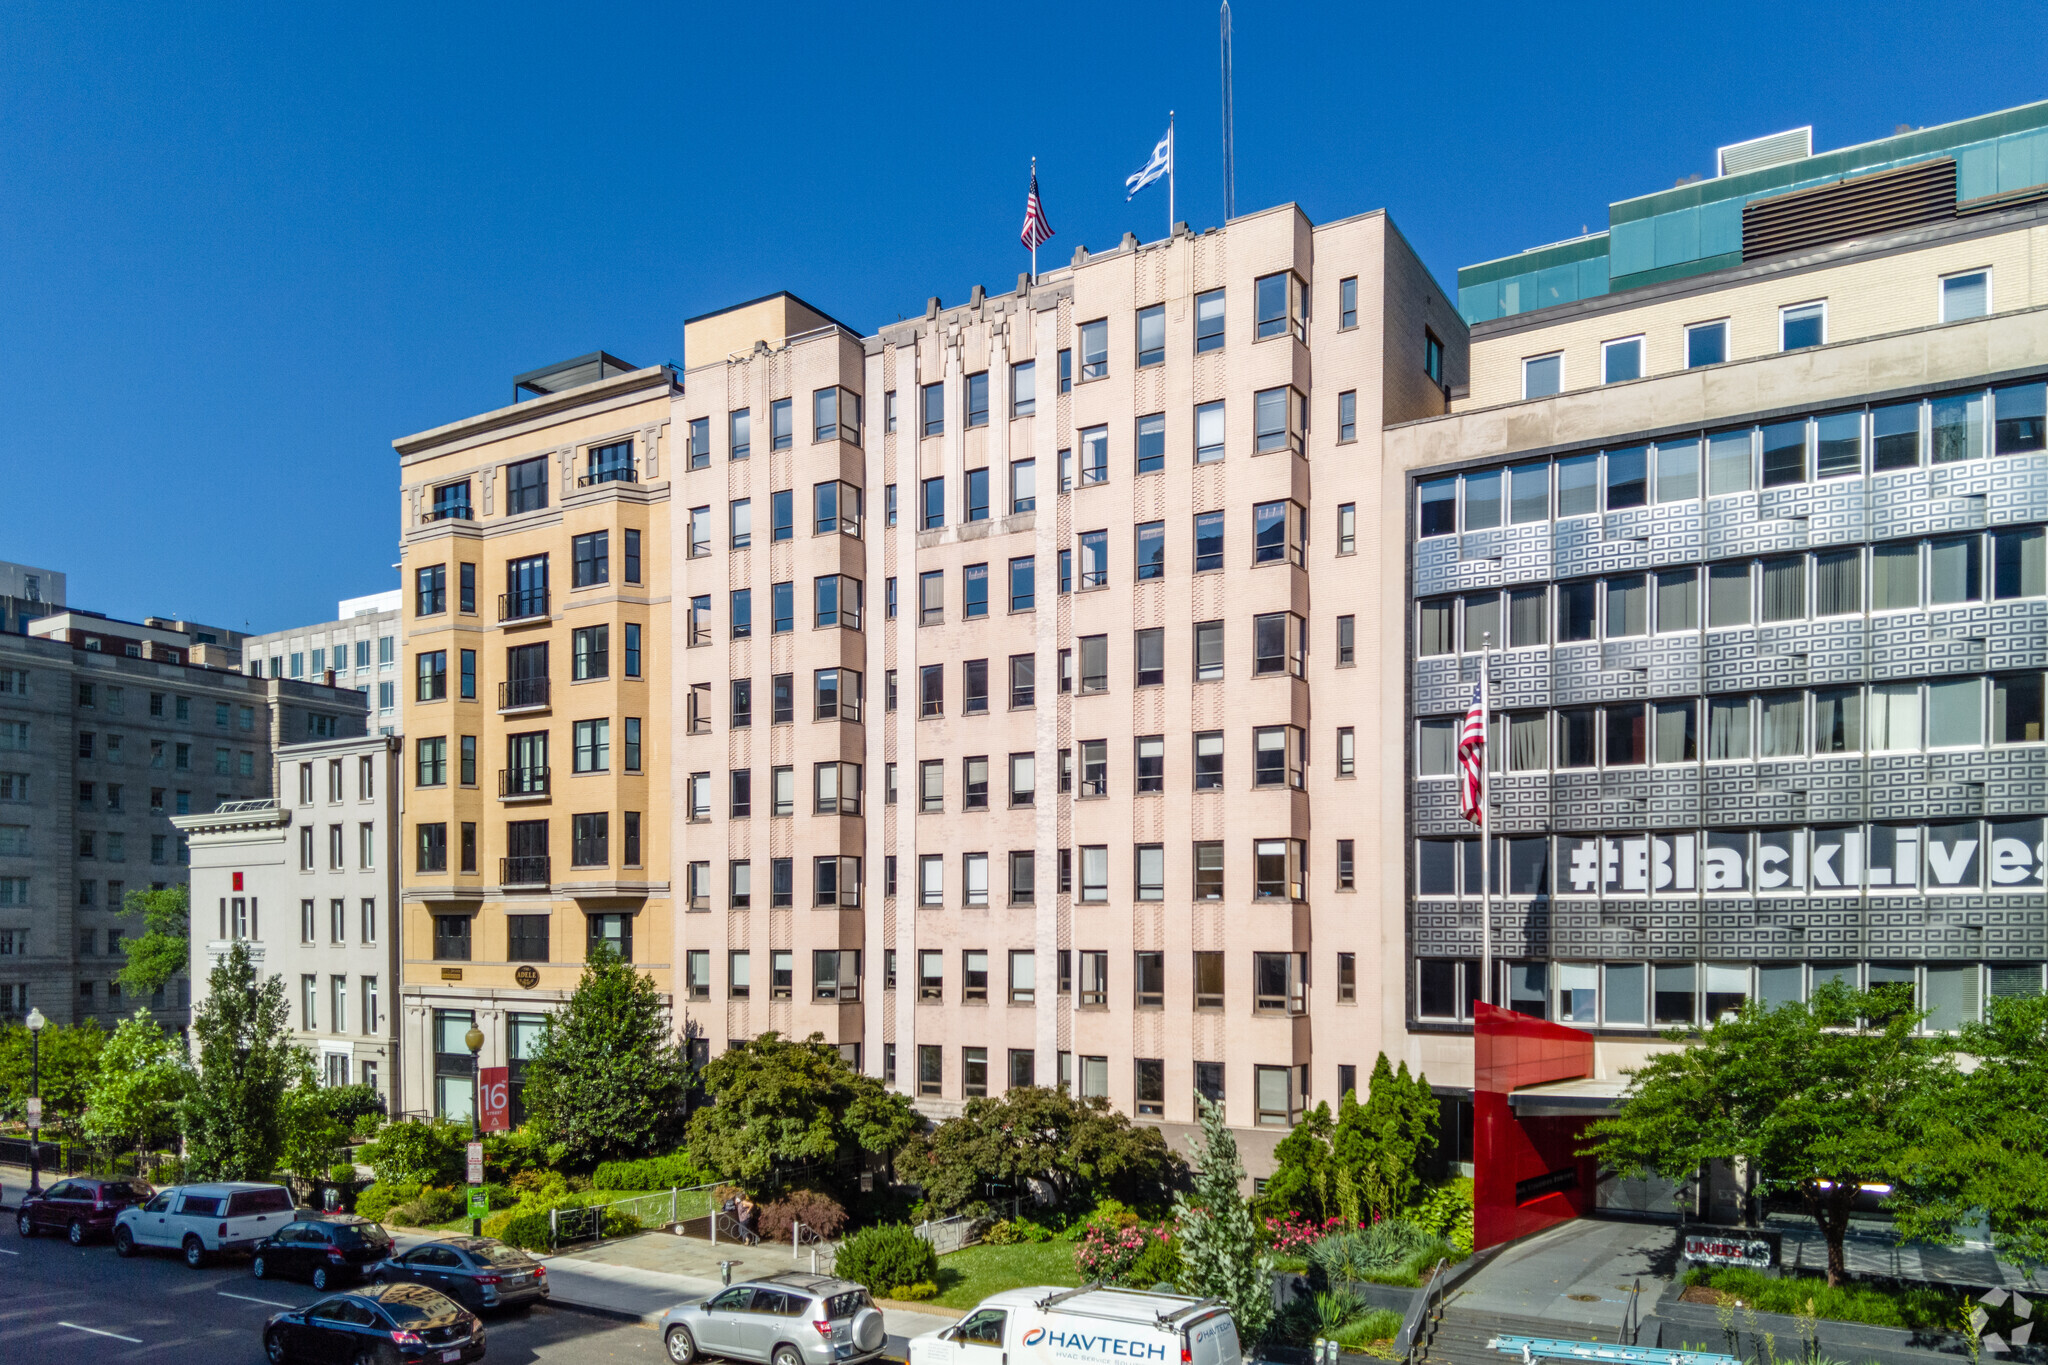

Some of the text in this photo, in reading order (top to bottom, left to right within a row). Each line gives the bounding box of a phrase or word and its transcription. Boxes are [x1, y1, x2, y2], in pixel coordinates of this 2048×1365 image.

[516, 971, 537, 979] ADELE
[1202, 1321, 1233, 1339] HAVTECH
[1048, 1330, 1165, 1361] HAVTECH
[1056, 1351, 1078, 1360] HVAC
